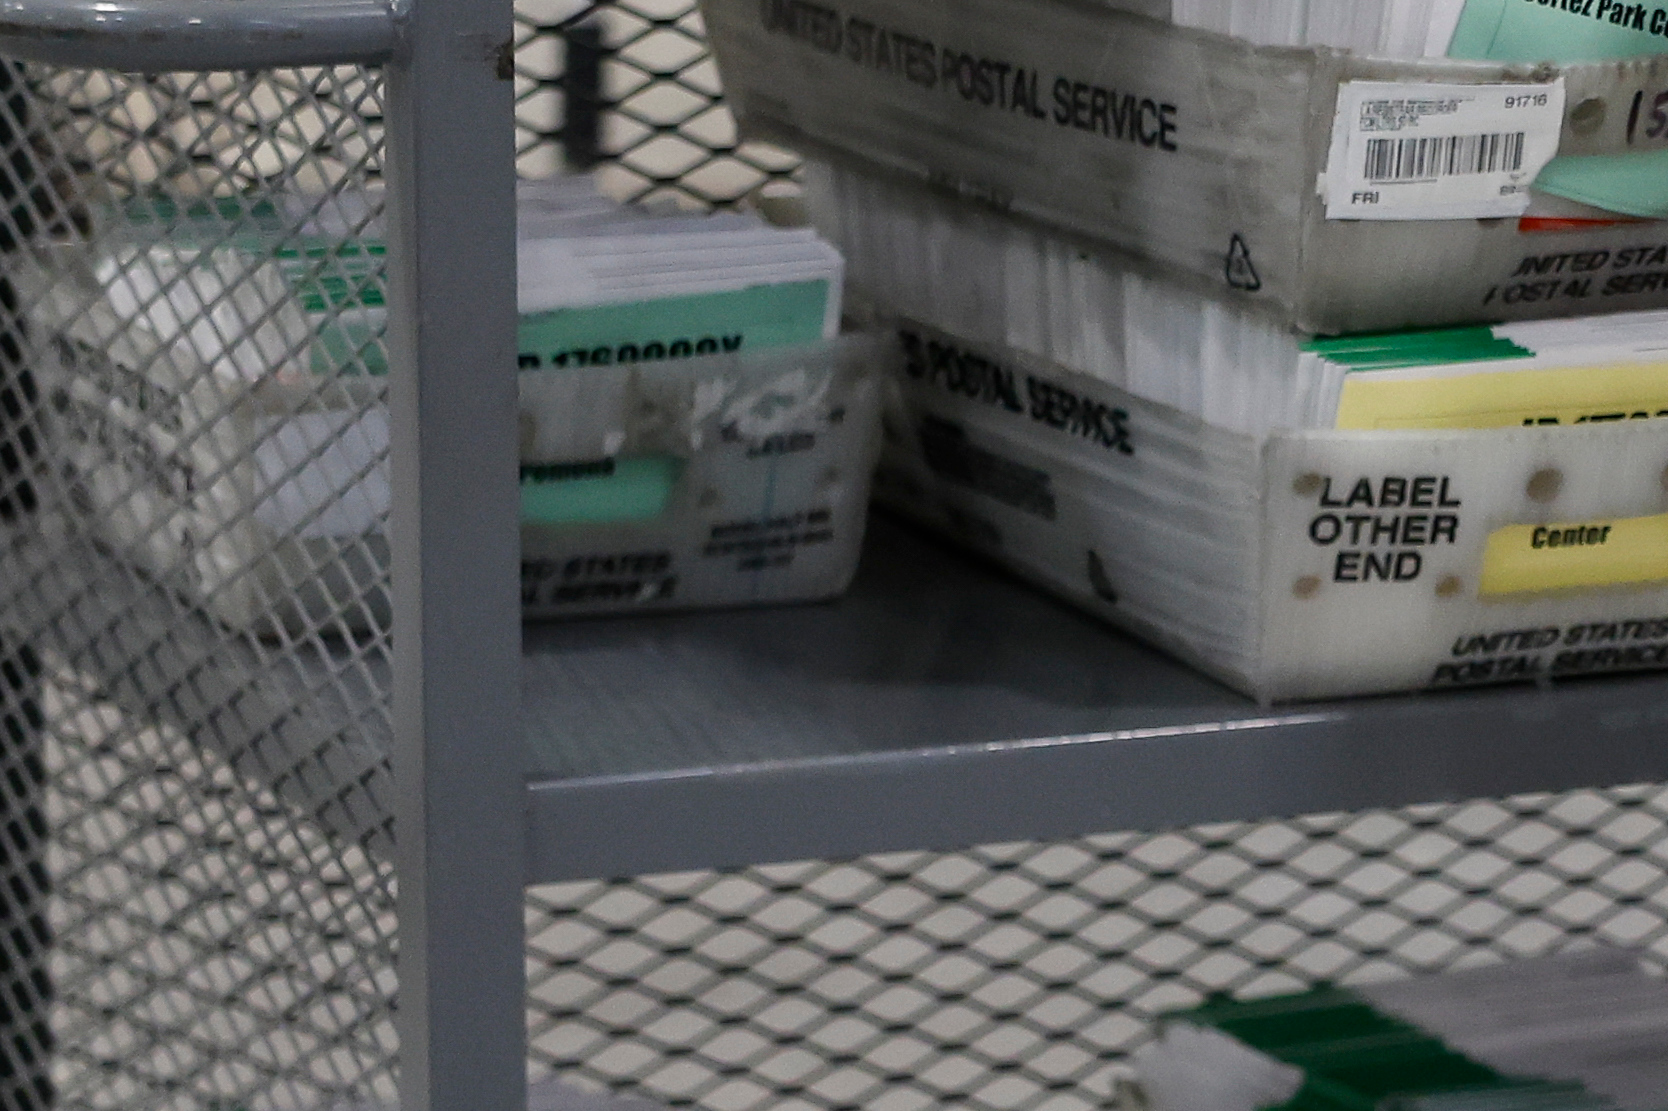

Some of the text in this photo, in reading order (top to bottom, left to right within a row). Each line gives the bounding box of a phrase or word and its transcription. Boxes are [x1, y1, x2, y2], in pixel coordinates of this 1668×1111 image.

[845, 15, 938, 87] STATES
[940, 48, 1047, 121] POSTAL
[1052, 76, 1179, 152] SERVICE
[1504, 94, 1548, 109] 91716
[1351, 191, 1379, 204] FRI
[1319, 477, 1462, 509] LABEL
[1308, 515, 1458, 546] OTHER
[1530, 522, 1614, 551] Center
[1333, 552, 1423, 583] END
[1451, 625, 1561, 657] UNITED
